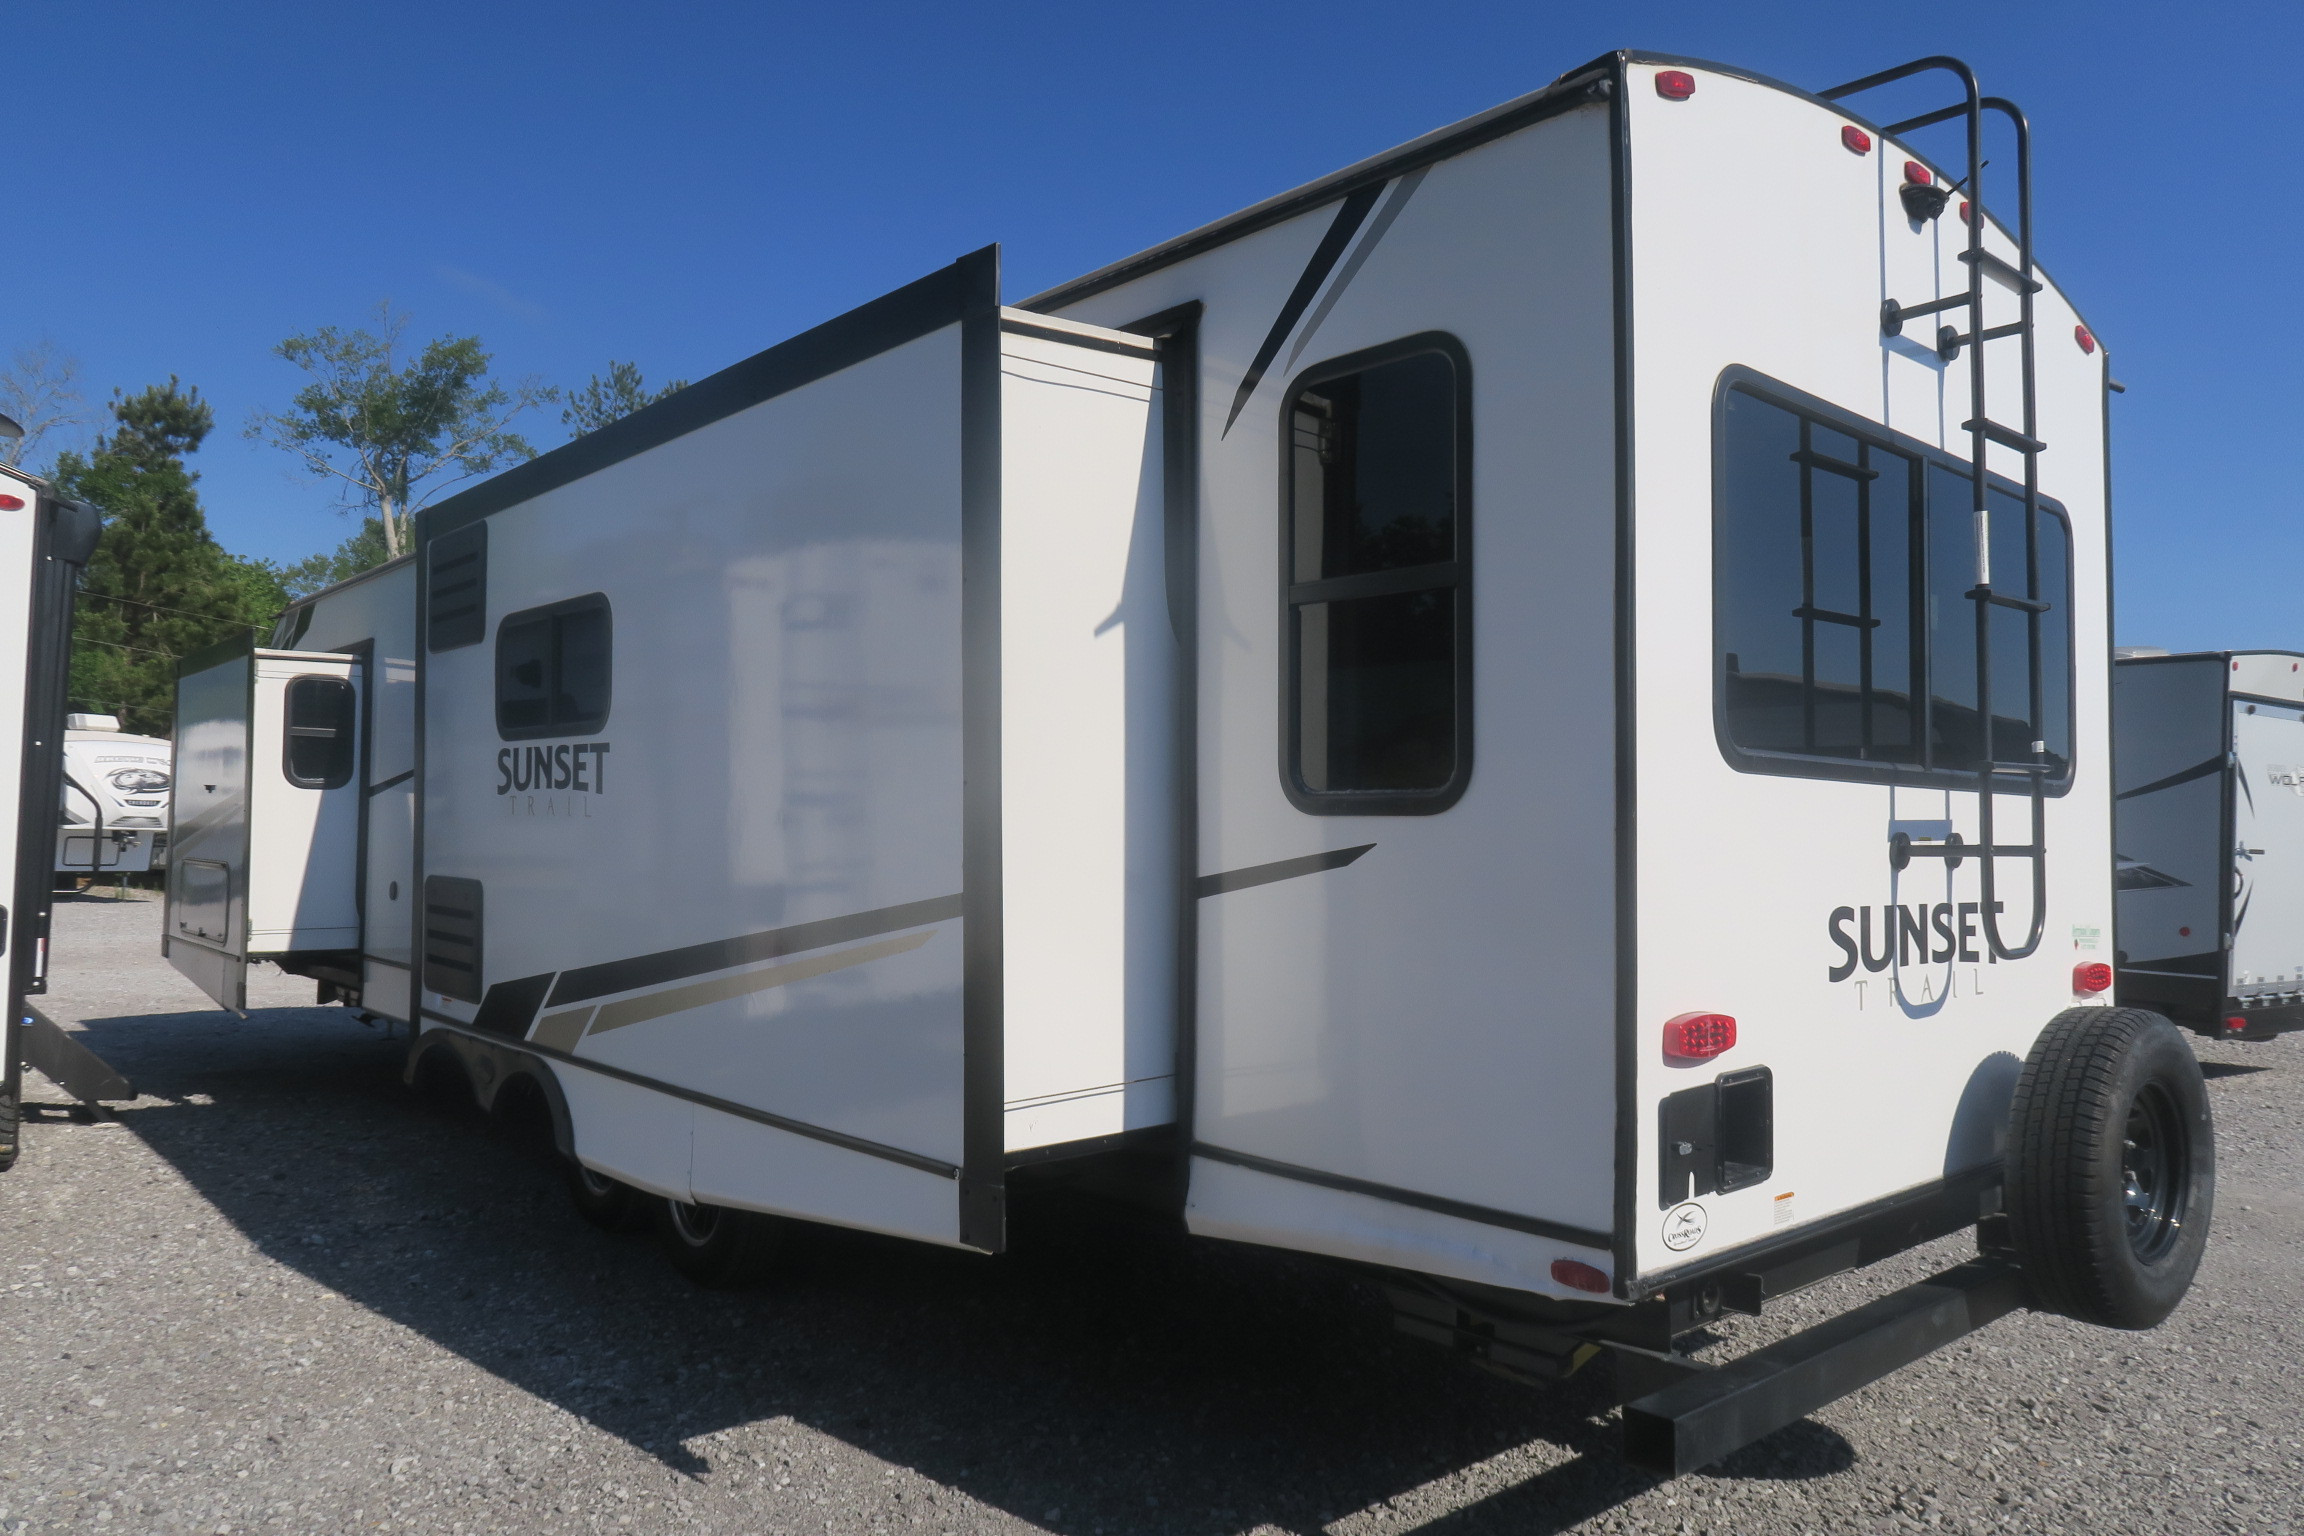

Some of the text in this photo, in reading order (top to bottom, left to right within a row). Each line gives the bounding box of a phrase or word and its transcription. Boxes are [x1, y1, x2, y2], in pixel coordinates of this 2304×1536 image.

[497, 742, 610, 795] SUNSET
[509, 795, 592, 817] TRAIL
[1854, 968, 1984, 1011] TRAIL
